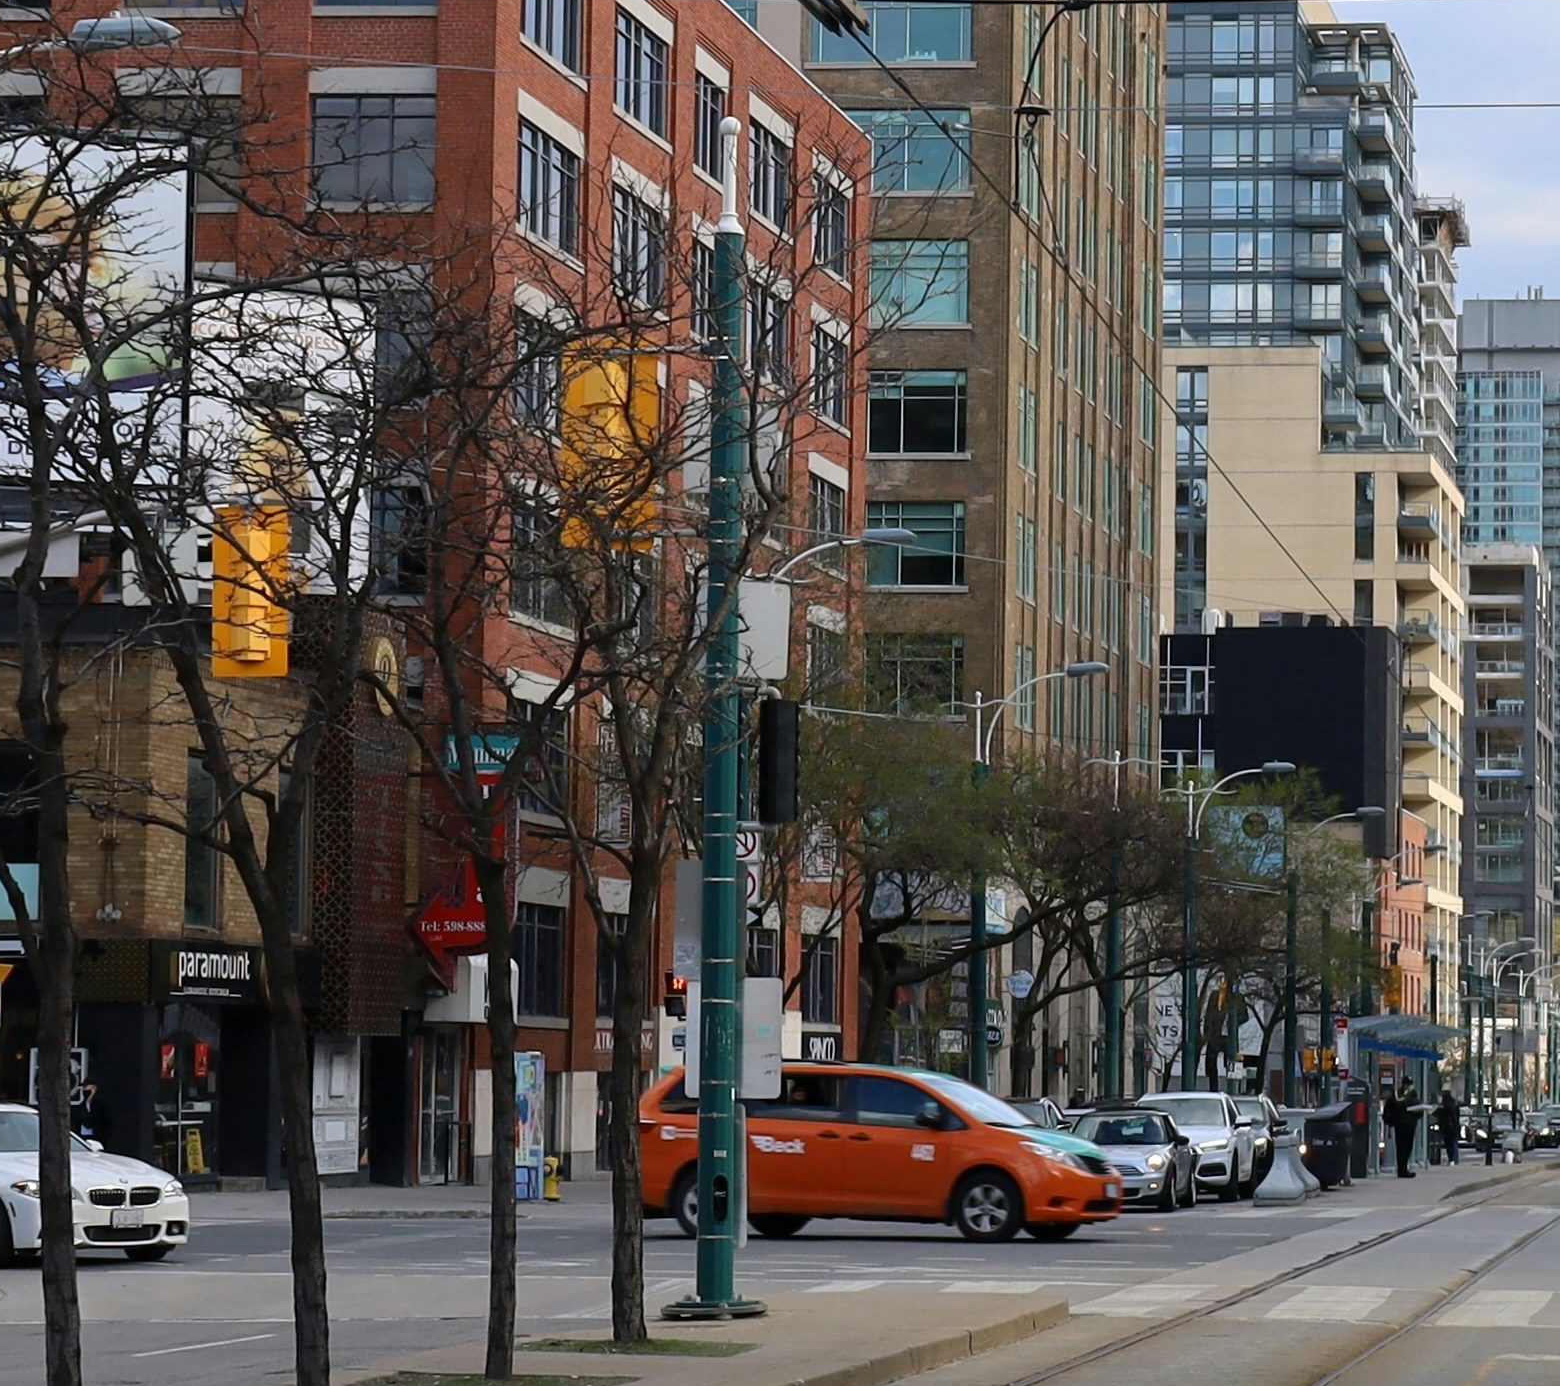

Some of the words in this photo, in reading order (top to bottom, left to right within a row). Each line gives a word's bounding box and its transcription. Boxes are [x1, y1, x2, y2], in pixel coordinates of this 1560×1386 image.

[419, 920, 441, 932] Tel:
[178, 951, 251, 987] paramount
[760, 1136, 806, 1154] Beck
